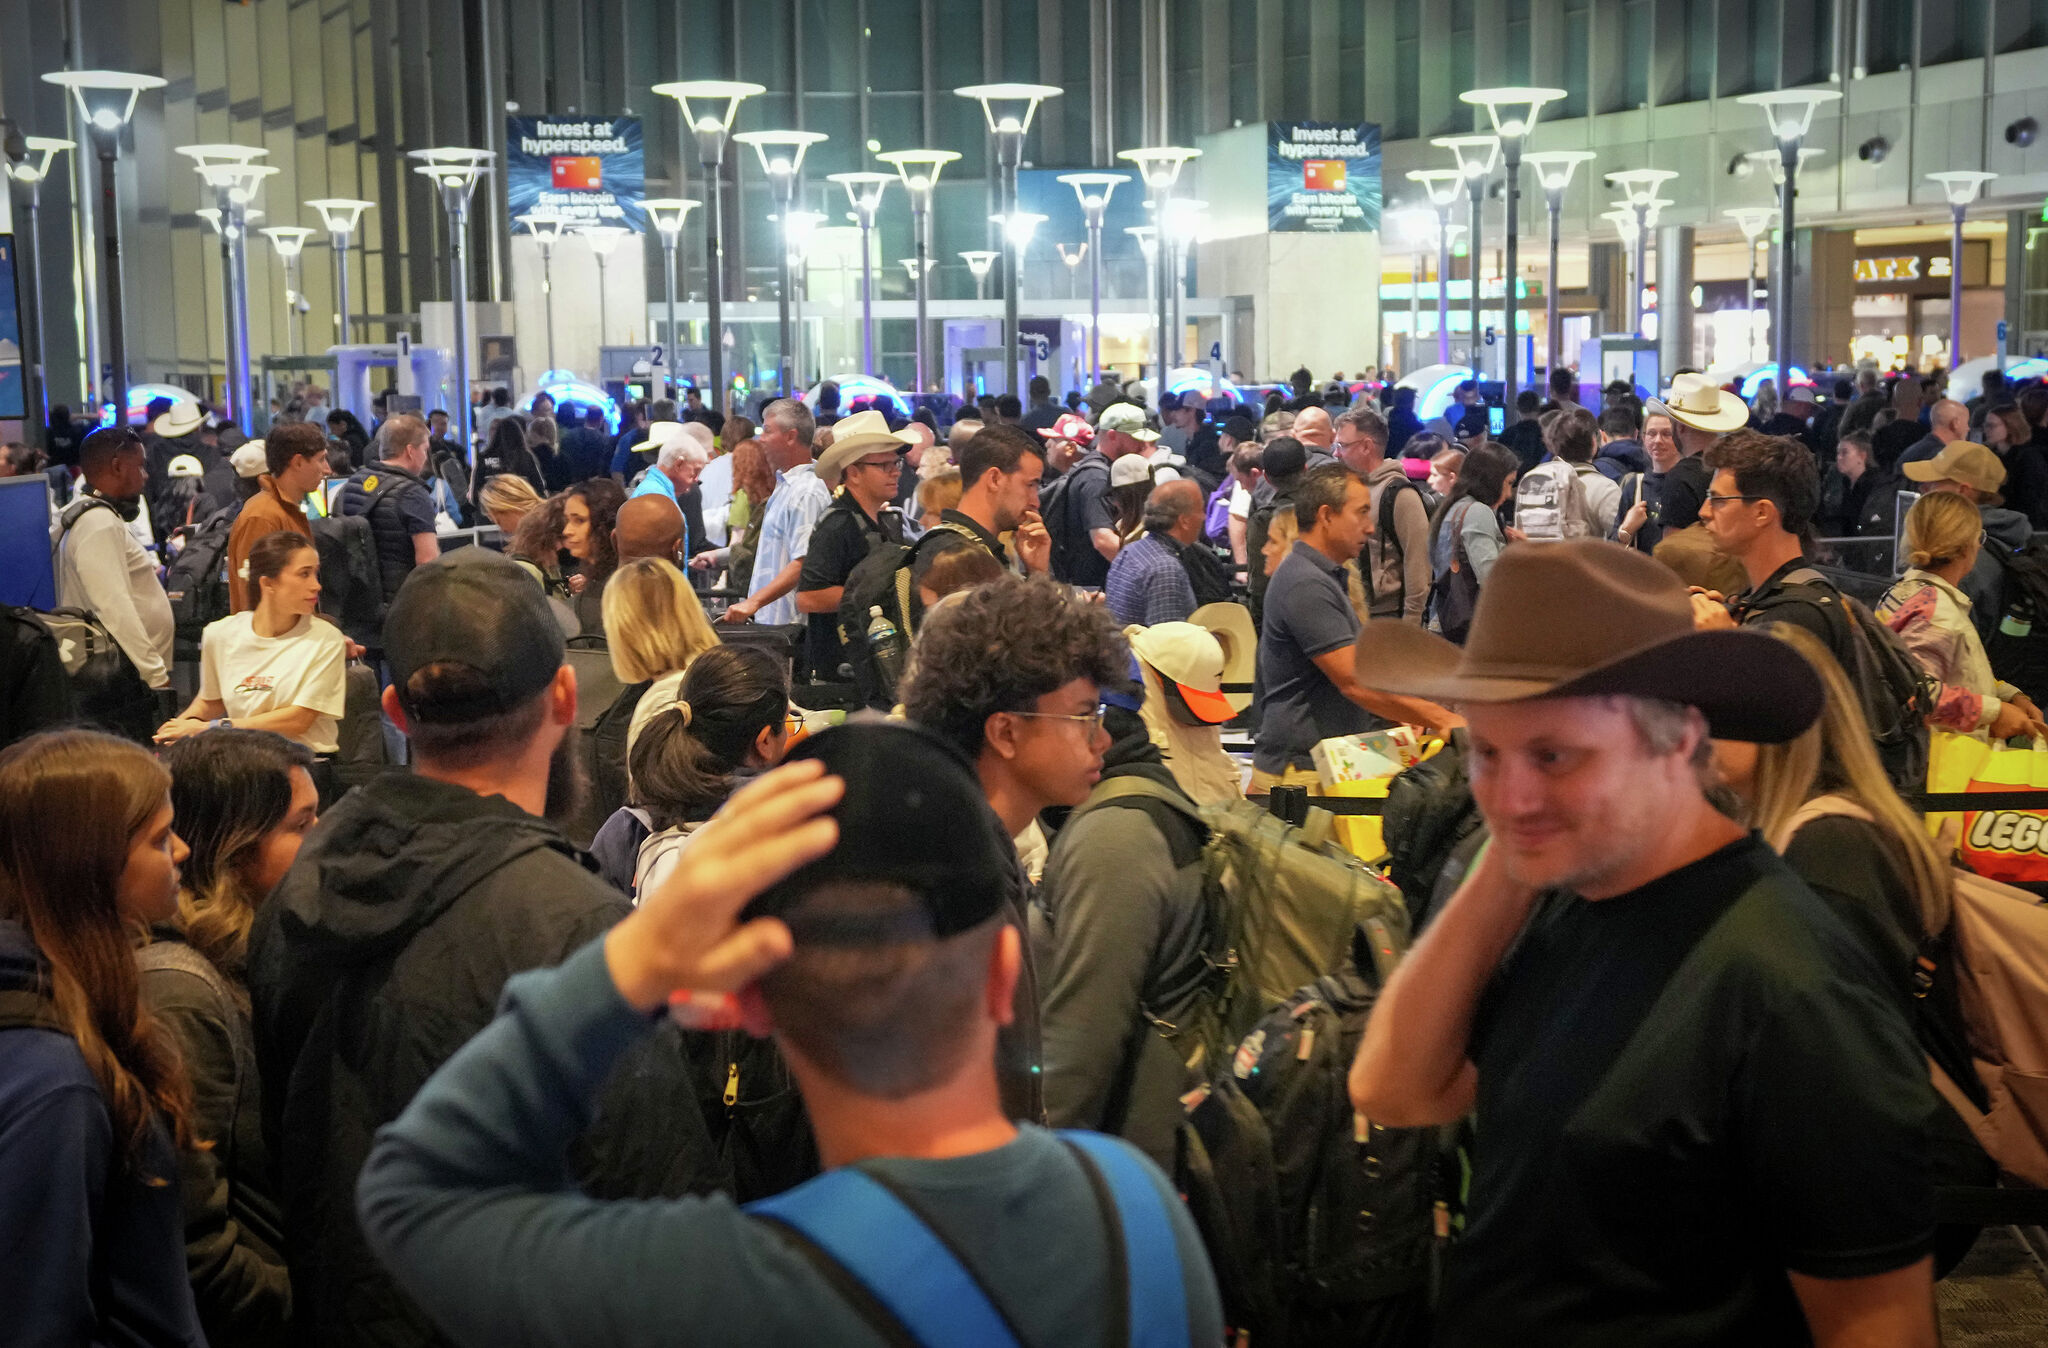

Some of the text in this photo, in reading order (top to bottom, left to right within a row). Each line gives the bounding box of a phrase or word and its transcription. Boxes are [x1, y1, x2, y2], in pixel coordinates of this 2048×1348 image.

[537, 121, 613, 136] Invest at
[1292, 126, 1357, 141] Invest at
[522, 136, 629, 154] hyperspeed.
[1279, 140, 1370, 159] hyperspeed.
[1485, 326, 1496, 345] 5
[400, 335, 408, 356] 1
[1038, 341, 1048, 361] 3
[1210, 341, 1221, 360] 4
[652, 346, 663, 366] 2
